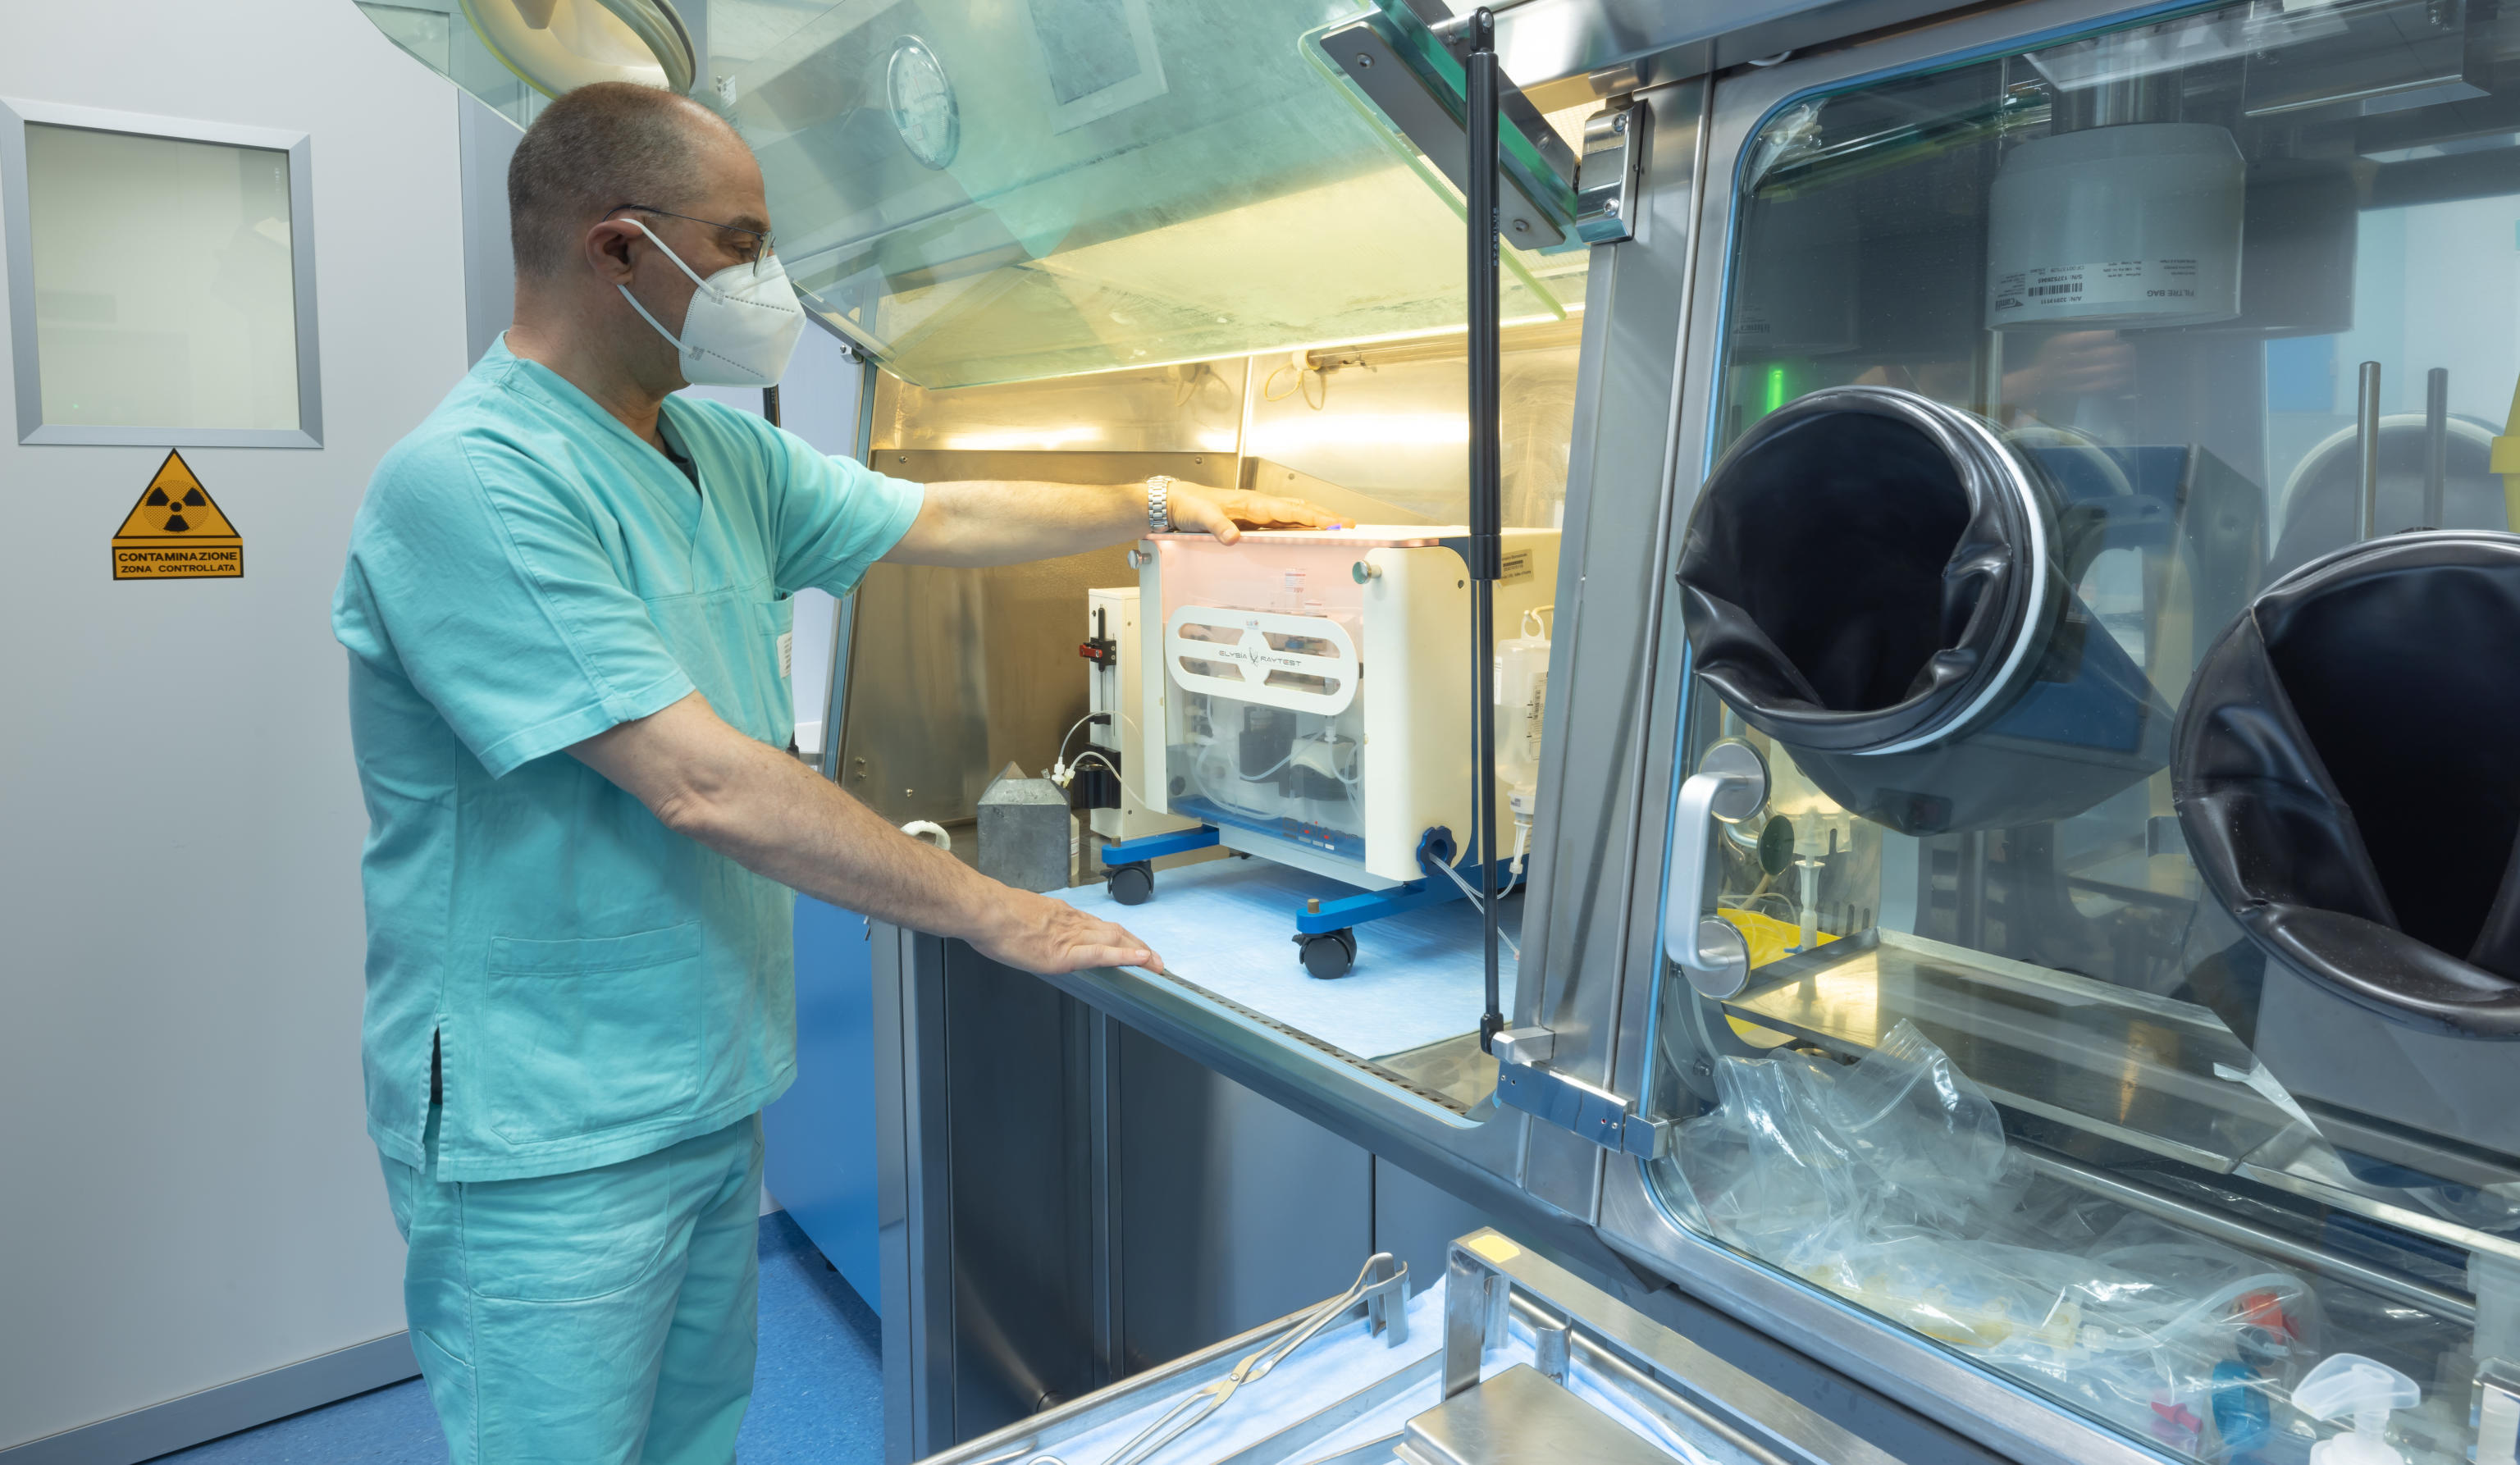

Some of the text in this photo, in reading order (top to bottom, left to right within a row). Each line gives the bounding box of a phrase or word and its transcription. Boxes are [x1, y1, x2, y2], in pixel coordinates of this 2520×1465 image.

[118, 552, 237, 561] CONTAMINAZIONE
[158, 564, 235, 573] CONTROLLATA
[1219, 650, 1302, 666] ELYSIA RAYTEST
